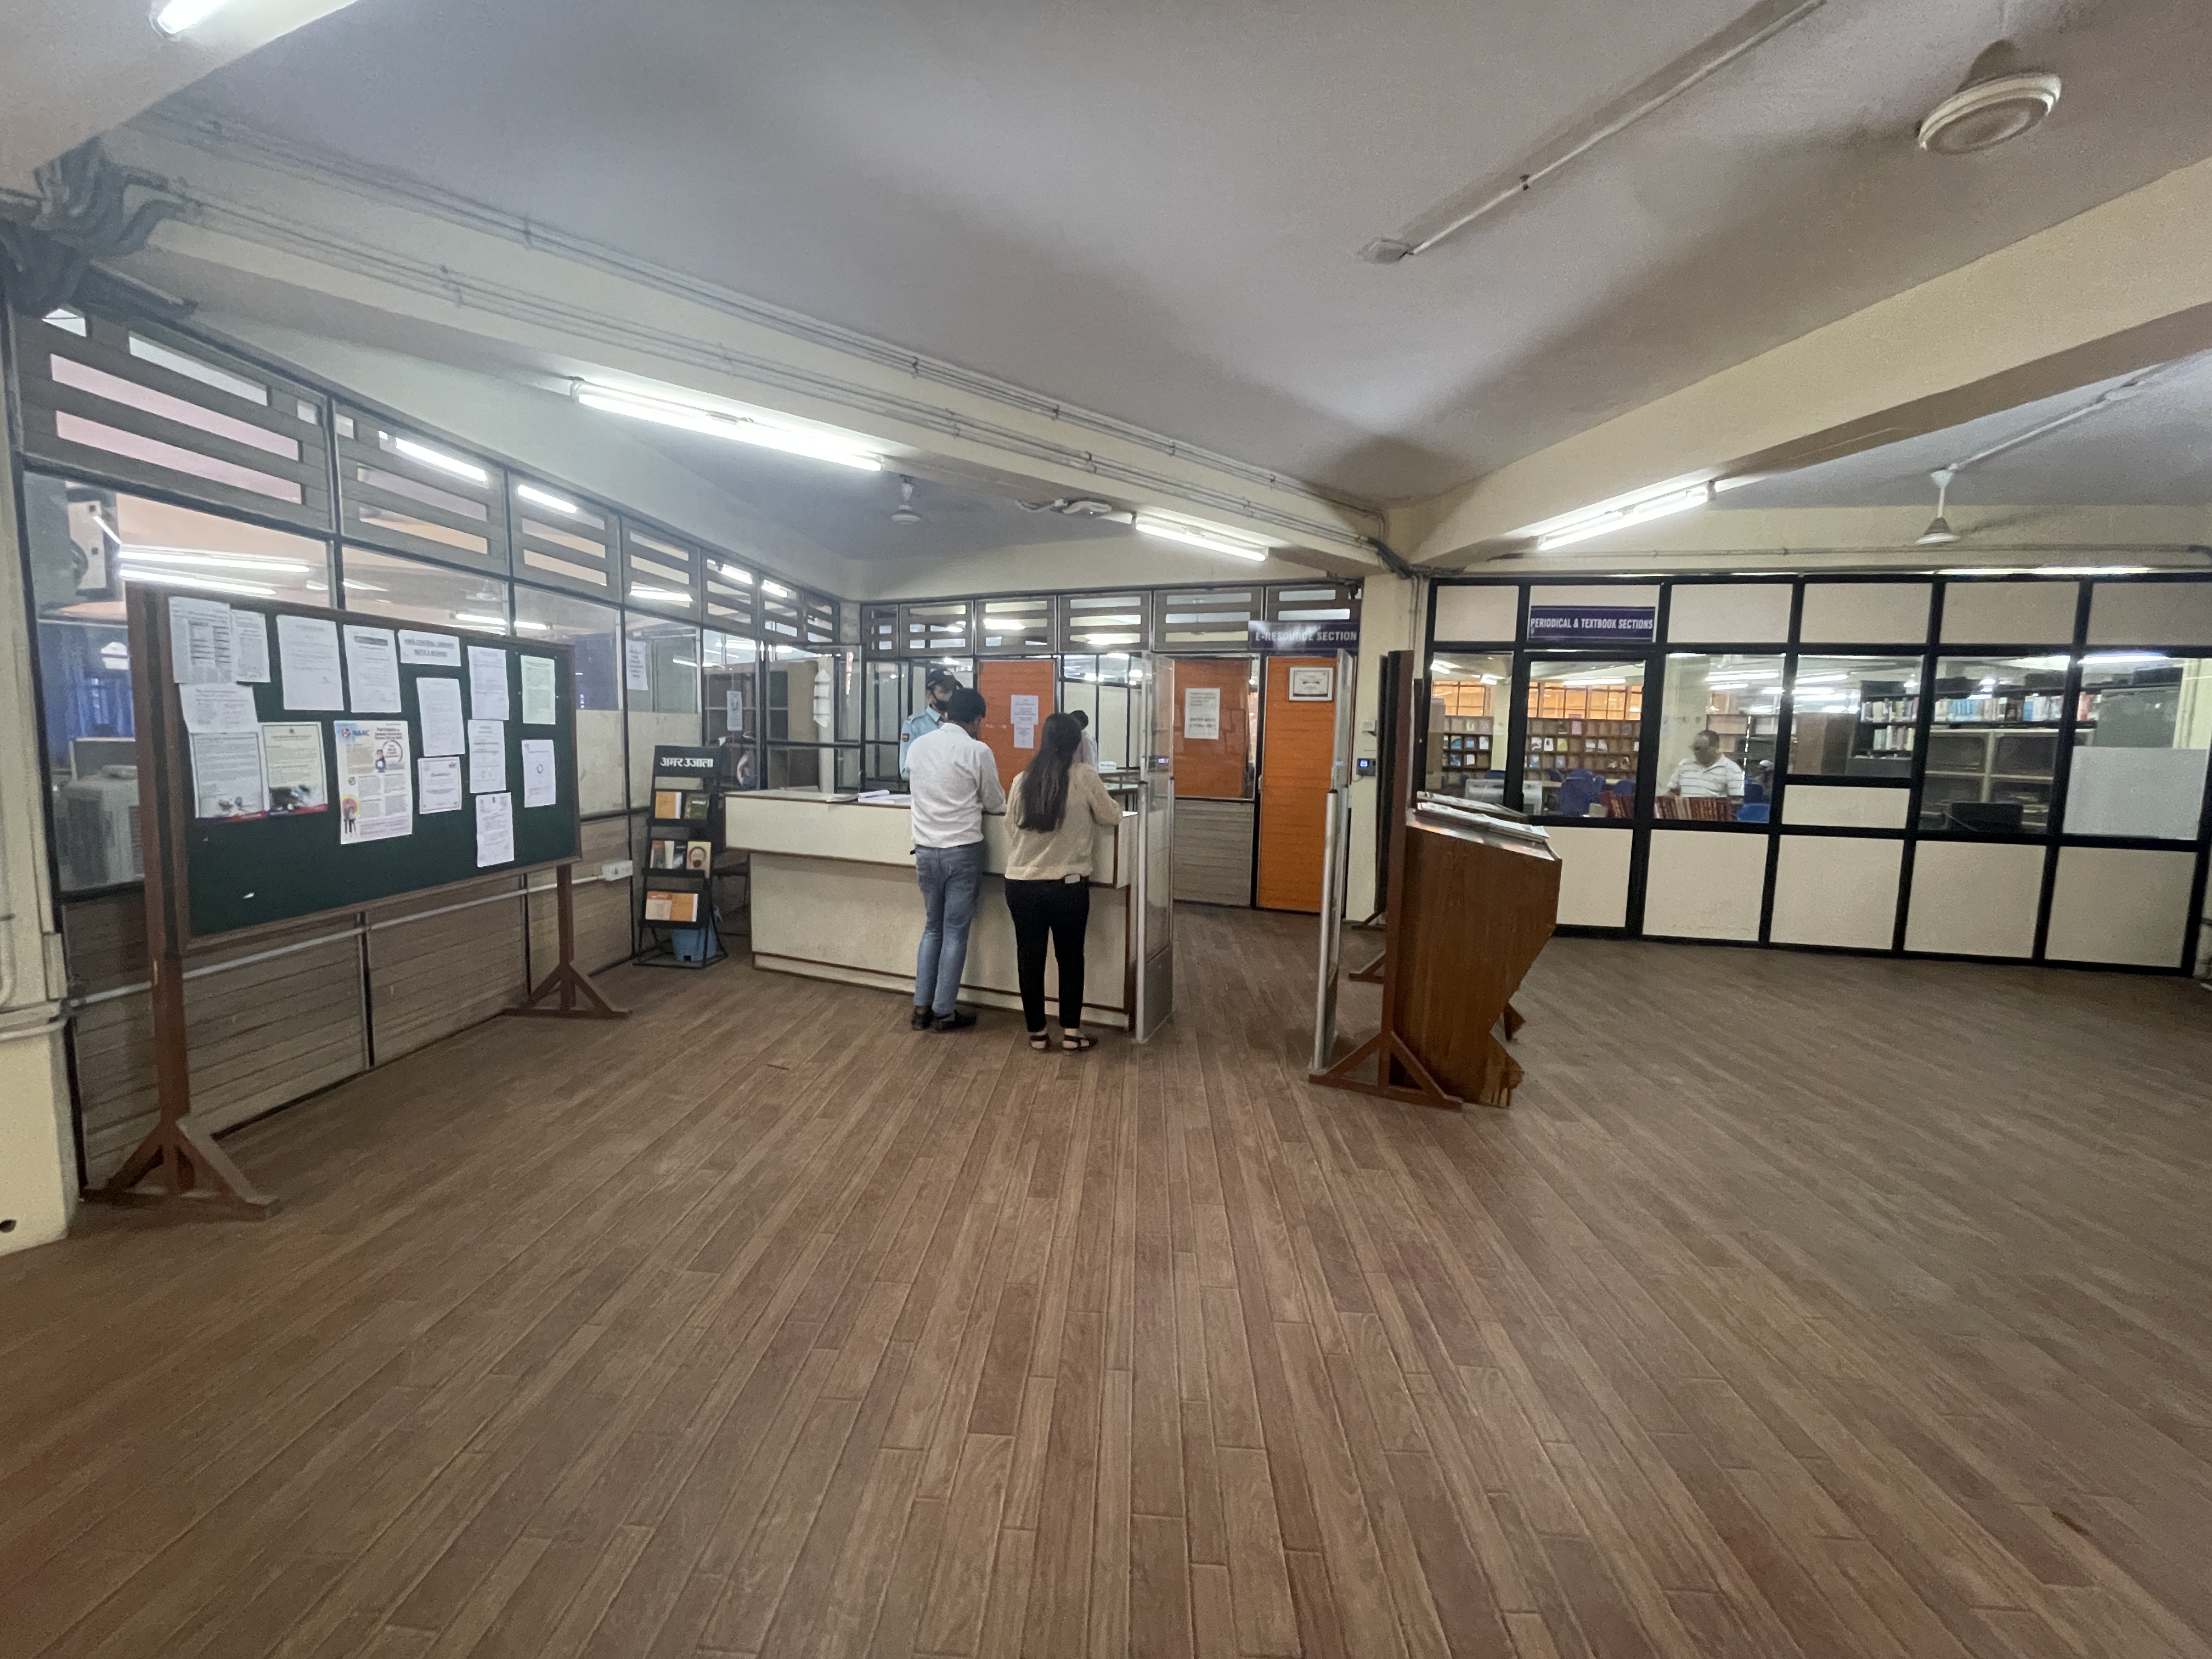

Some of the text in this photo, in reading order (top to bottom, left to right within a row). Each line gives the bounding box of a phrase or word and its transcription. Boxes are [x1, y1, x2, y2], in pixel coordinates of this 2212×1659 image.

[1530, 618, 1654, 629] PERIODICAL & TEXTBOOK SECTIONS
[1317, 631, 1357, 641] SECTION
[660, 757, 714, 768] अमर उजाला
